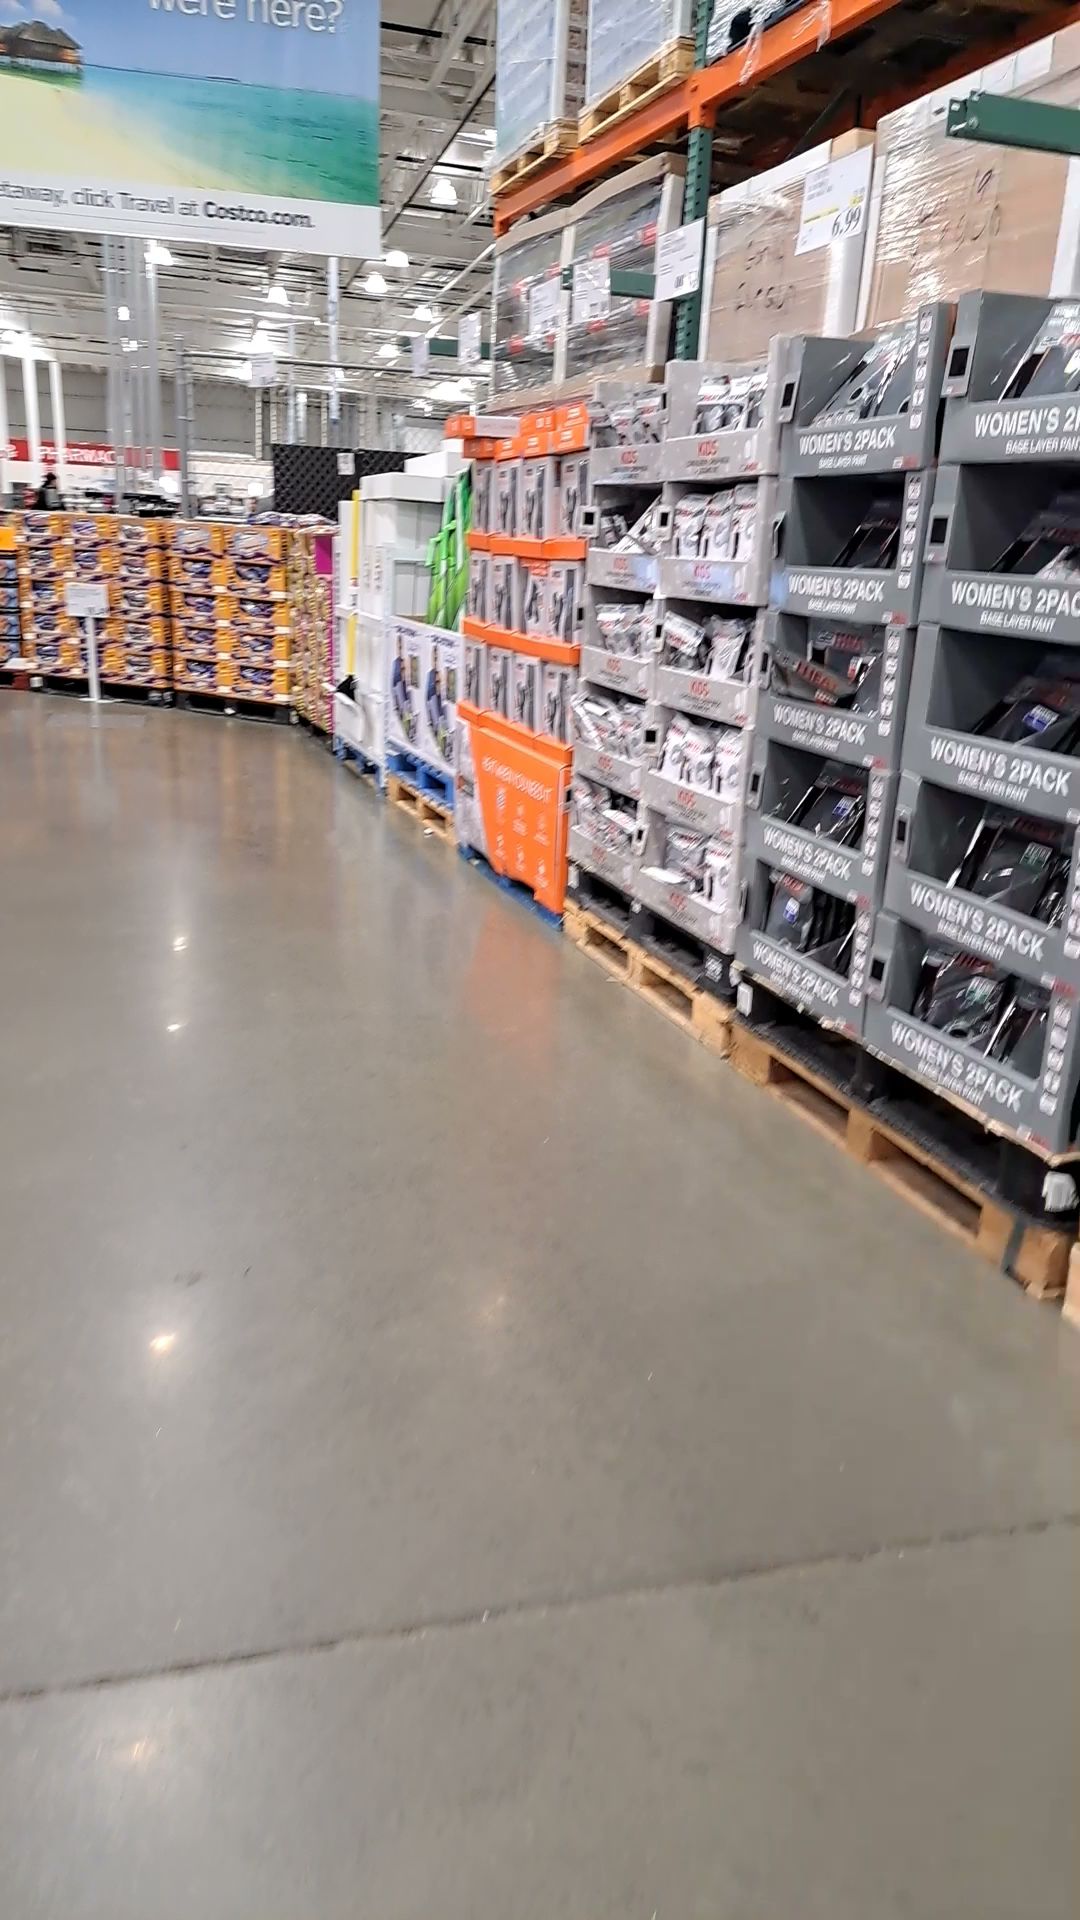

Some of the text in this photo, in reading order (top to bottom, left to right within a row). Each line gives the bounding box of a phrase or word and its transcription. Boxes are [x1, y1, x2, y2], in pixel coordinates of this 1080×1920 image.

[71, 188, 116, 208] click
[116, 191, 175, 214] Travel
[178, 201, 199, 217] at
[831, 205, 861, 238] 6.99
[975, 407, 1060, 438] WOMEN'S
[800, 424, 897, 456] WOMEN'S 2PACK
[1005, 436, 1080, 454] BASE LAYER PAN
[788, 574, 885, 602] WOMEN'S 2PACK
[952, 580, 1032, 612] WOMEN'S
[773, 703, 826, 735] WOMEN'S
[825, 717, 868, 746] 2PACK
[930, 736, 1072, 797] WOMEN'S 2PACK
[763, 825, 852, 880] WOMEN'S 2PACK
[911, 882, 1046, 962] WOMEN'S 2PACK
[891, 1020, 1024, 1113] WOMEN'S 2PACK
